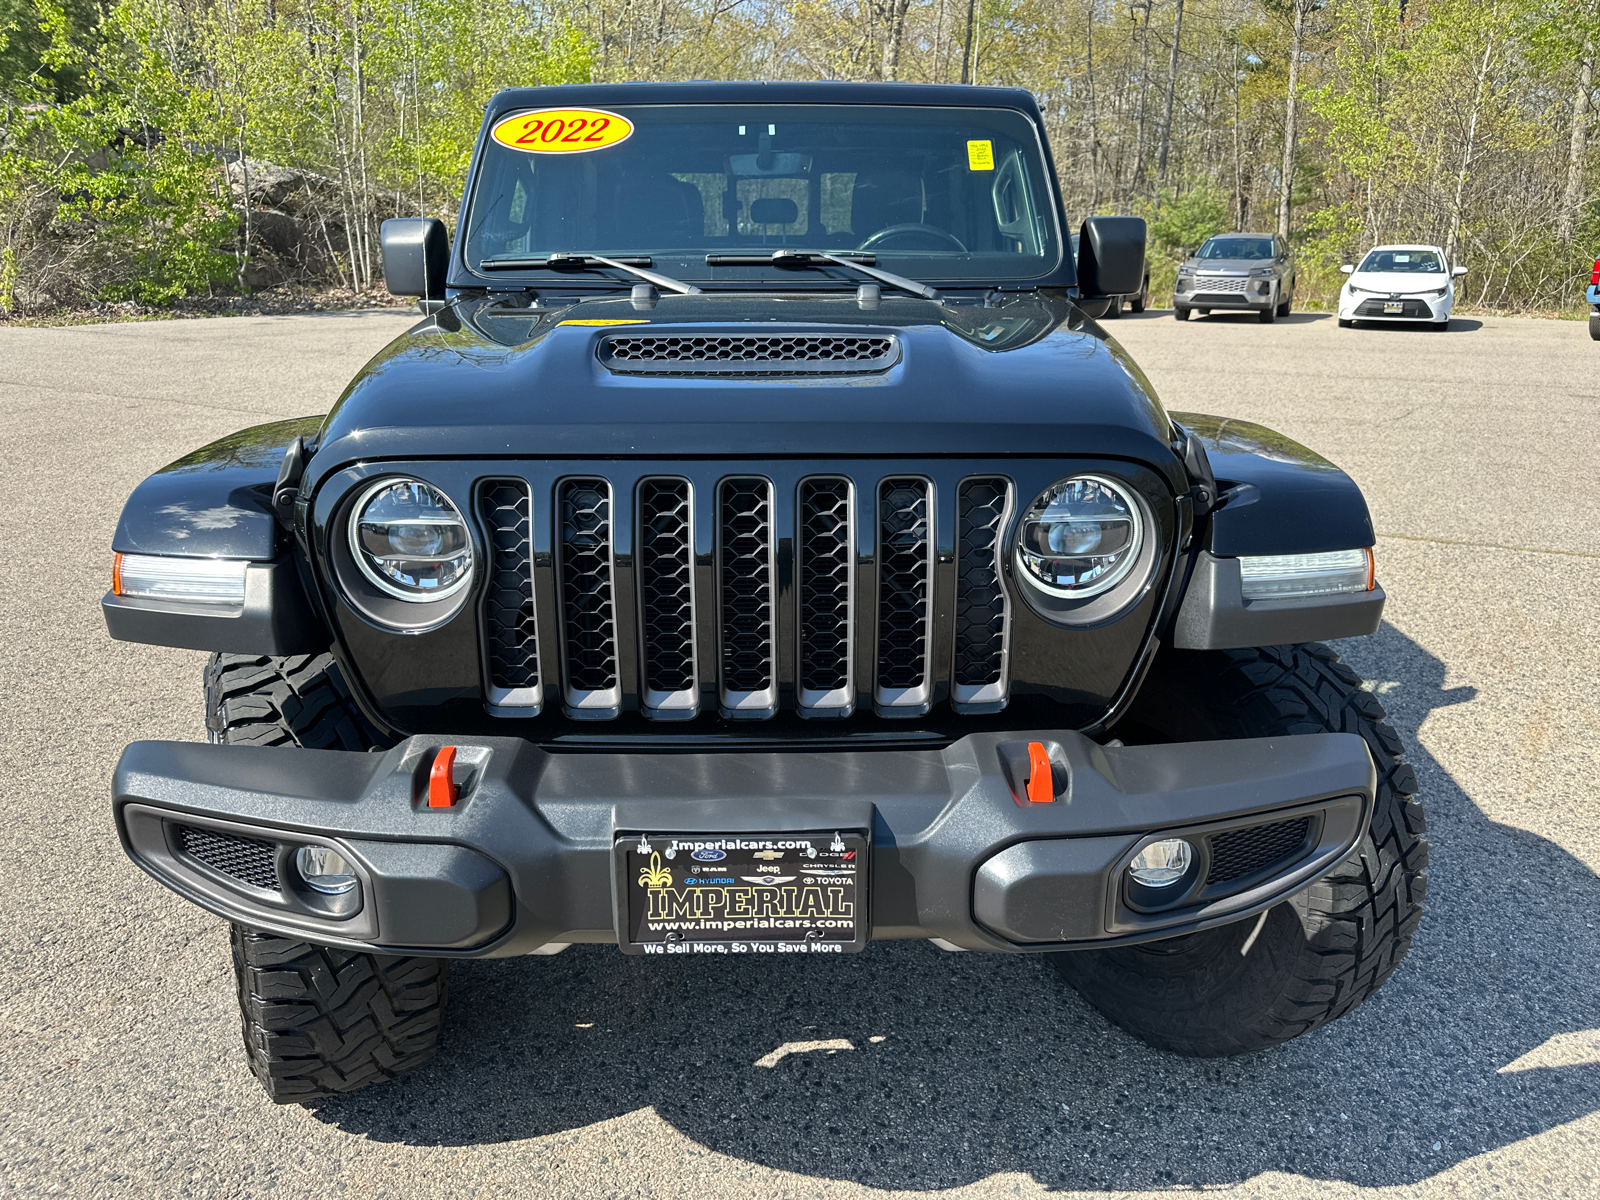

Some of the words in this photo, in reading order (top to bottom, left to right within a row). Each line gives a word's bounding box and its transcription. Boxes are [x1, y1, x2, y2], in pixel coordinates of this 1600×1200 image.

[515, 118, 610, 143] 2022
[671, 839, 811, 852] Imperialcars.com
[756, 864, 780, 874] Jeep
[699, 877, 735, 885] HYUNDAI
[816, 877, 853, 885] TOYOTA
[647, 887, 854, 919] IMPERIAL
[647, 918, 854, 931] www.imperialcars.com
[643, 944, 664, 954] We
[666, 943, 690, 954] Sell
[693, 943, 729, 955] More,
[731, 943, 748, 954] So
[750, 943, 774, 953] You
[777, 942, 808, 953] Save
[810, 942, 842, 953] More
